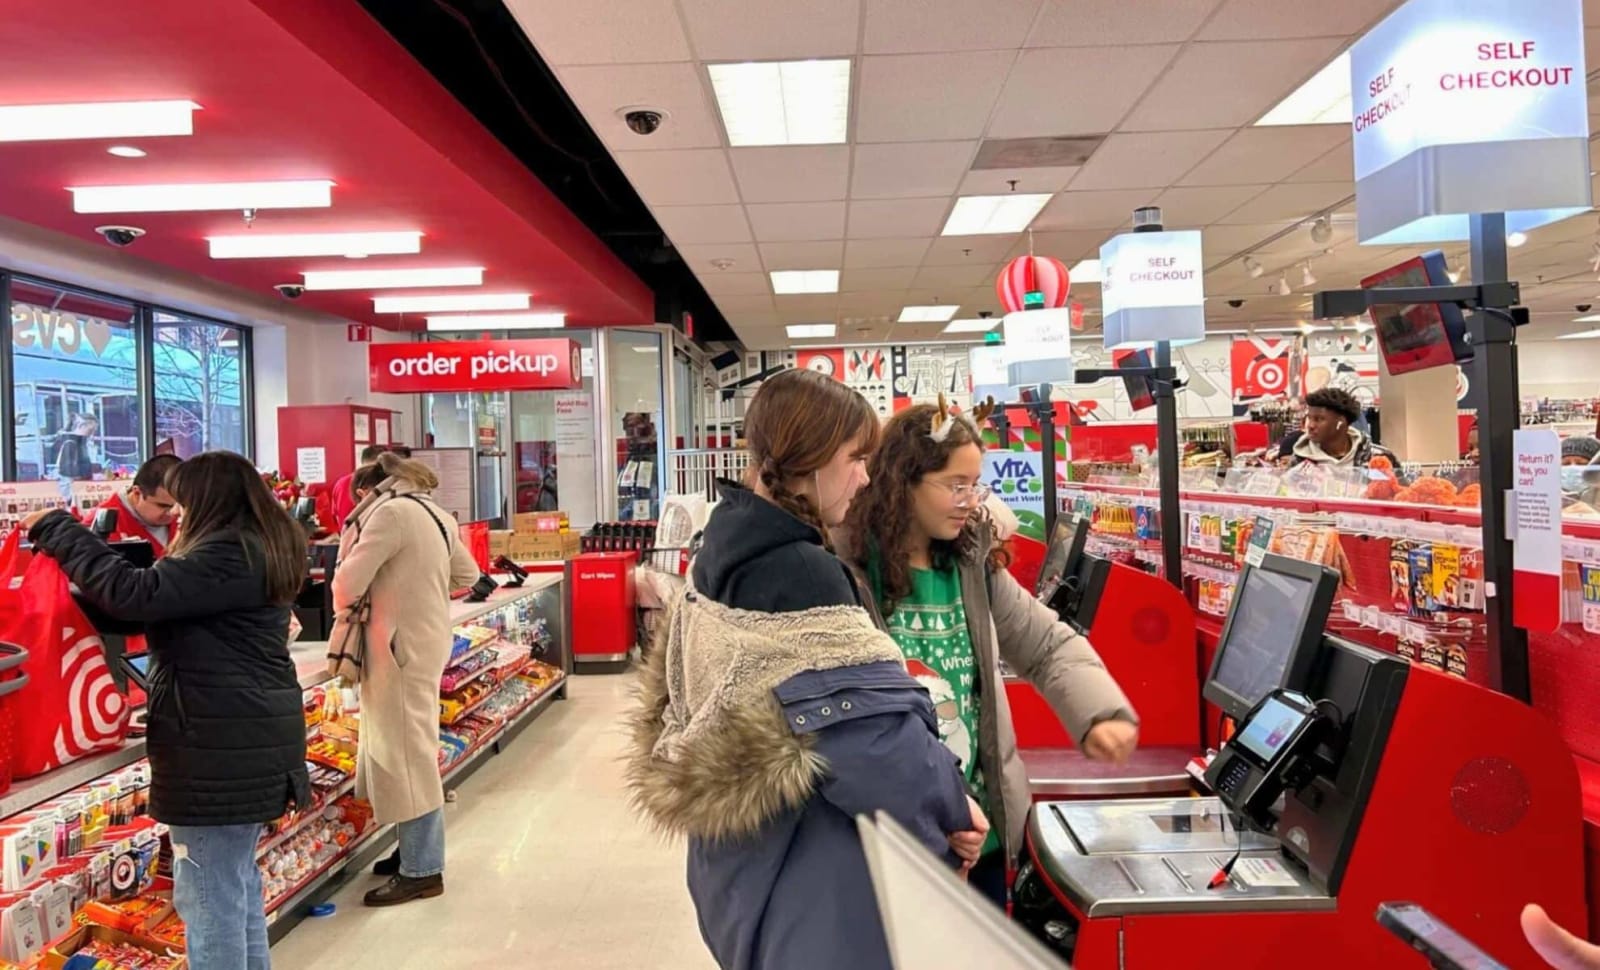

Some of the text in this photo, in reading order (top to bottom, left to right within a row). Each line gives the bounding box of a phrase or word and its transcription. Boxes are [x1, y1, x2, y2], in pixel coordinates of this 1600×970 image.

[1478, 41, 1536, 61] SELF
[1369, 67, 1395, 98] SELF
[1439, 67, 1573, 92] CHECKOUT
[1148, 257, 1176, 267] SELF
[1129, 270, 1195, 282] CHECKOUT
[389, 349, 558, 379] order pickup
[1519, 453, 1554, 465] Return it?
[993, 459, 1035, 477] VITA
[1519, 466, 1548, 477] Yes, you
[991, 479, 1042, 494] COCO
